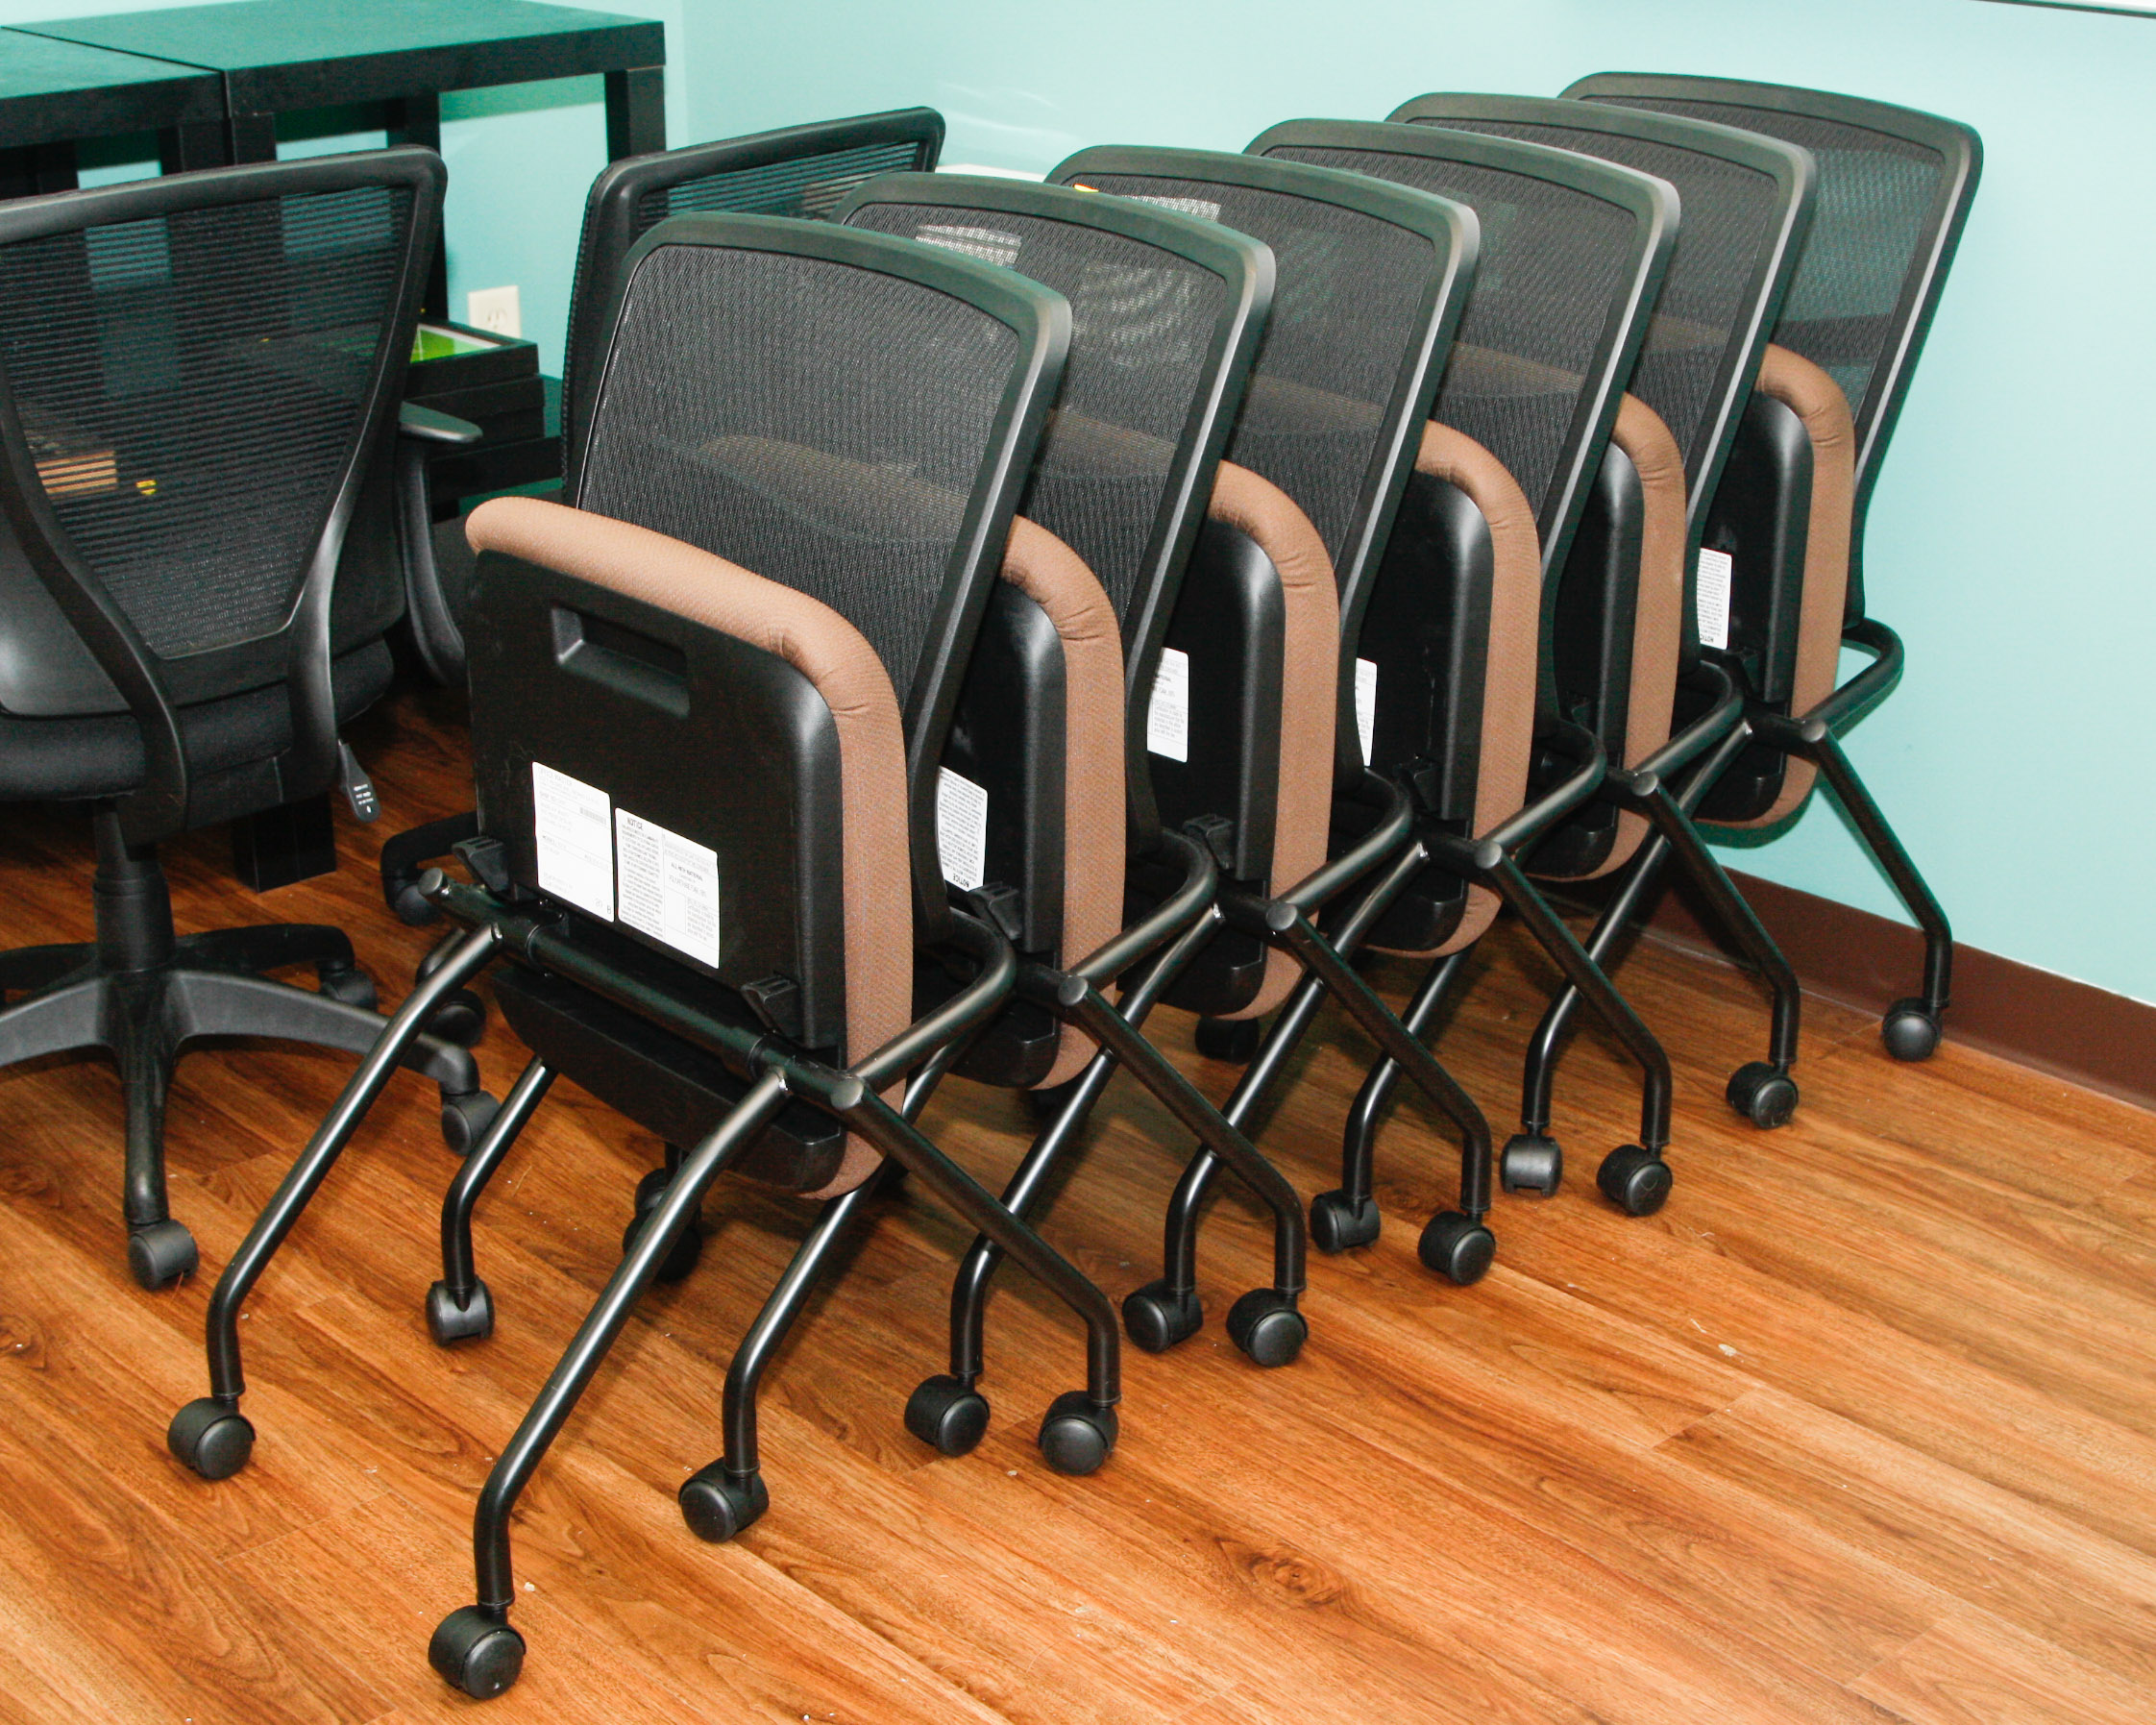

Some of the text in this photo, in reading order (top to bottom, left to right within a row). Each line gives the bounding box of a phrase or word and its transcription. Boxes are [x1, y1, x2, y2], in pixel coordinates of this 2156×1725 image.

[627, 817, 643, 830] NOTICE
[686, 869, 703, 882] MATERIAL
[953, 873, 969, 888] NOTICE
